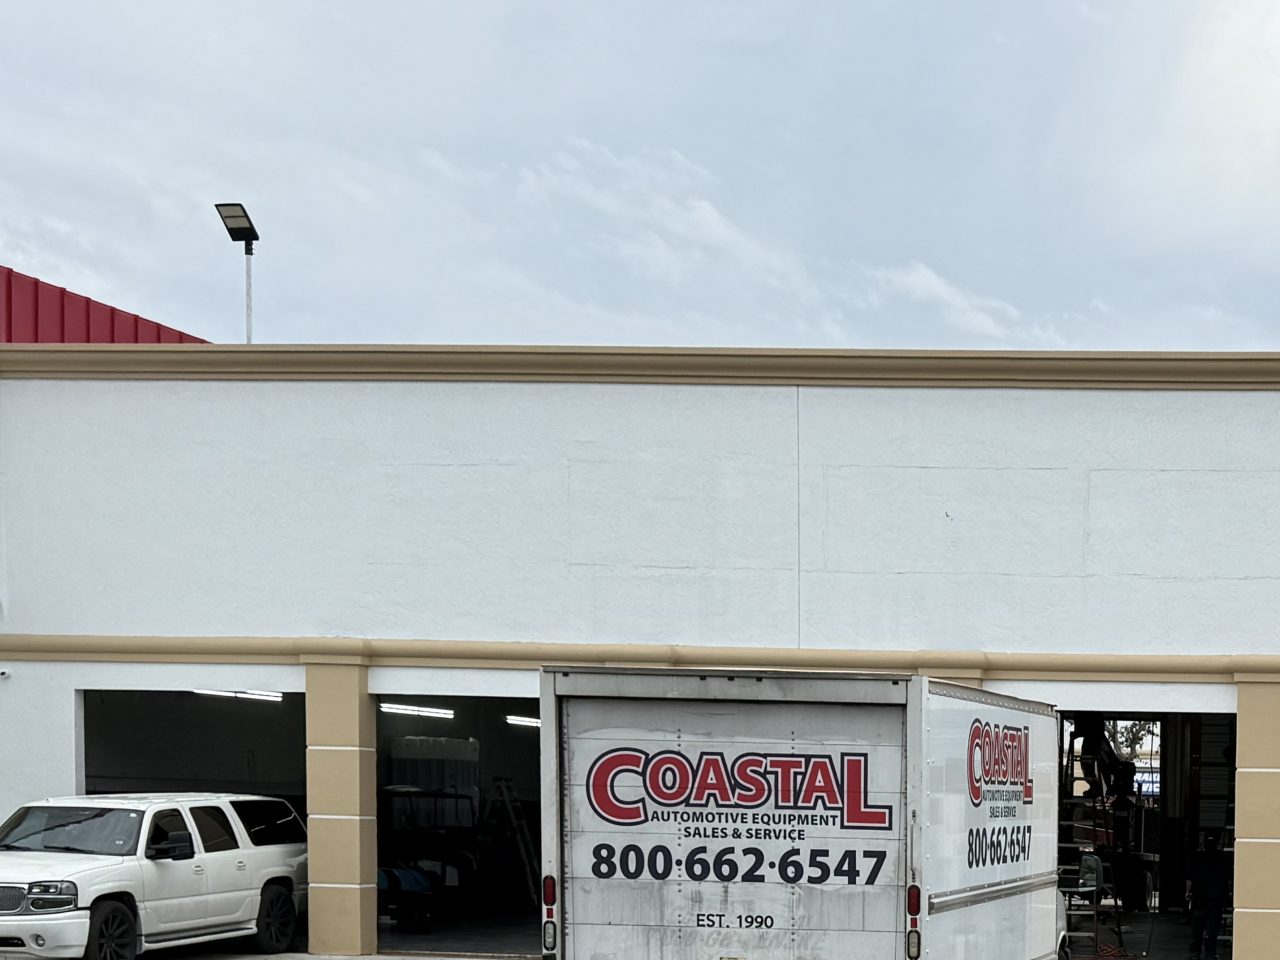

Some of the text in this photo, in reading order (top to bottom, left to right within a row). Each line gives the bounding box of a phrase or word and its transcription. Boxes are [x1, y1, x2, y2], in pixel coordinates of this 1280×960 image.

[967, 717, 1034, 808] COASTAL
[586, 747, 893, 831] COASTAL
[650, 811, 839, 827] AUTOMOTIVE EQUIPMENT
[683, 827, 806, 841] SALES & SERVICE
[696, 913, 774, 929] EST. 1990
